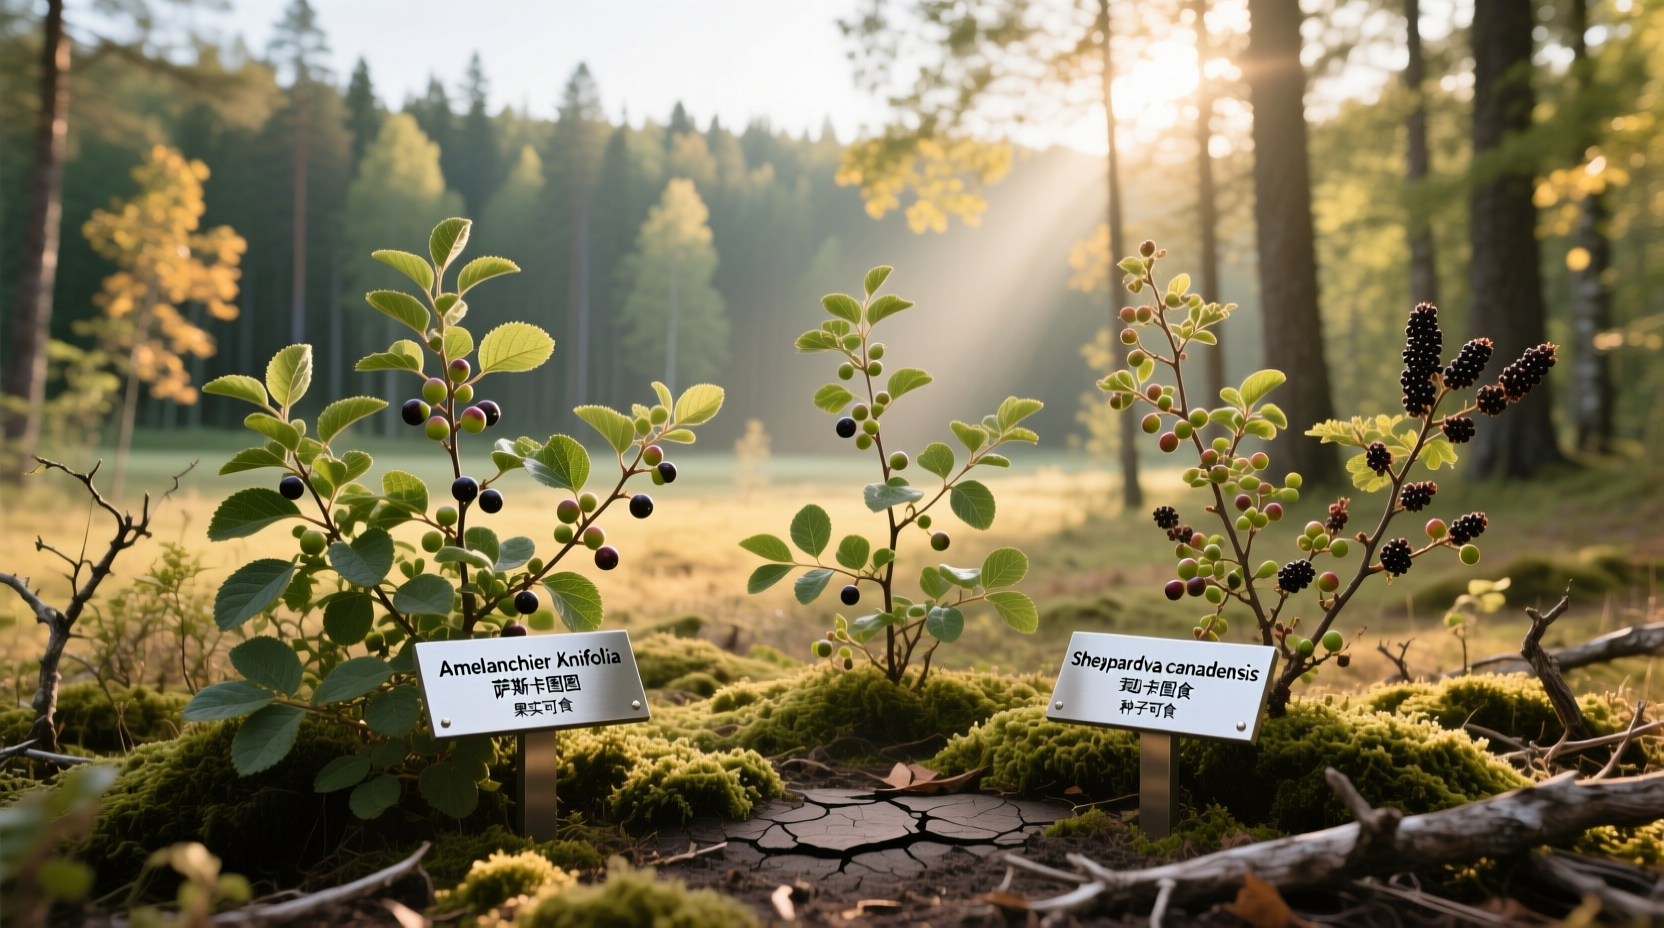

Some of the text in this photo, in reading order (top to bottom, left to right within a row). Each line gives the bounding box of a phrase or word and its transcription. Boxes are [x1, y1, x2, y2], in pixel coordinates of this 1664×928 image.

[439, 647, 621, 677] Amelanchier Knifolia
[1165, 661, 1259, 682] canadensis
[1119, 699, 1177, 719] 种子可食
